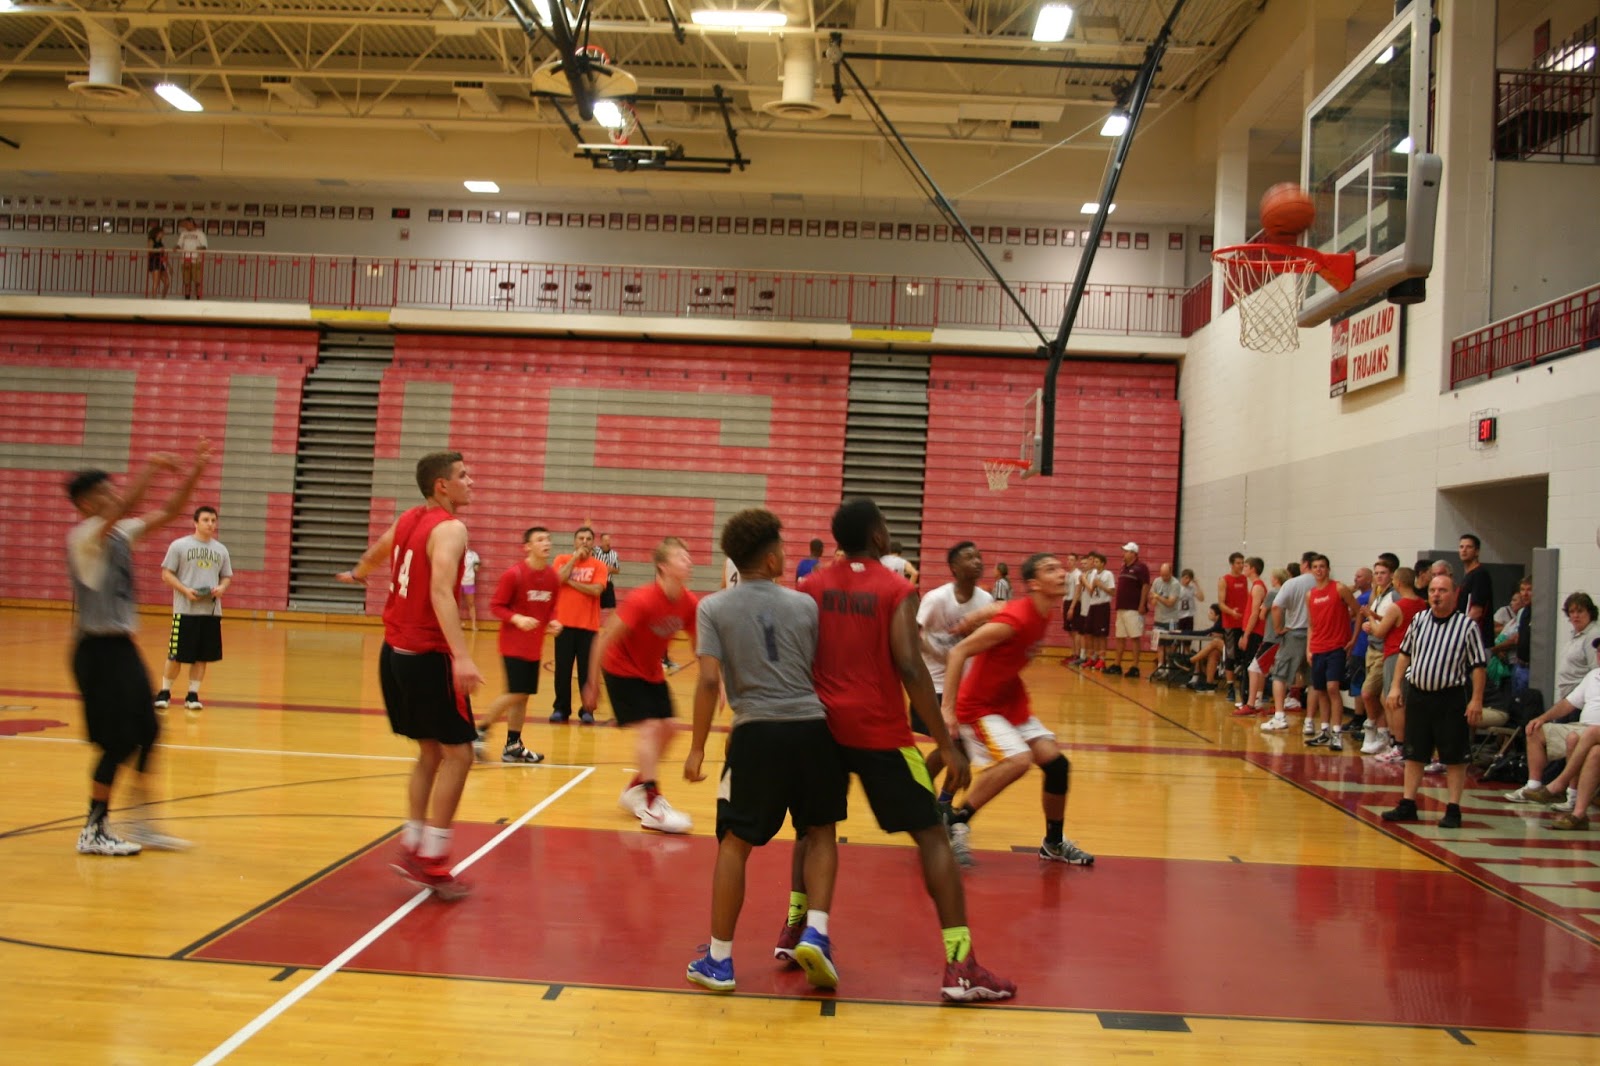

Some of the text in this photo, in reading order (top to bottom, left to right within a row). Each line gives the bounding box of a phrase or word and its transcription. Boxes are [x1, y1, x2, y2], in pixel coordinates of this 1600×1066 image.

[1351, 306, 1395, 348] PARKLAND
[1353, 344, 1389, 381] TROJANS
[187, 547, 221, 567] COLORADO
